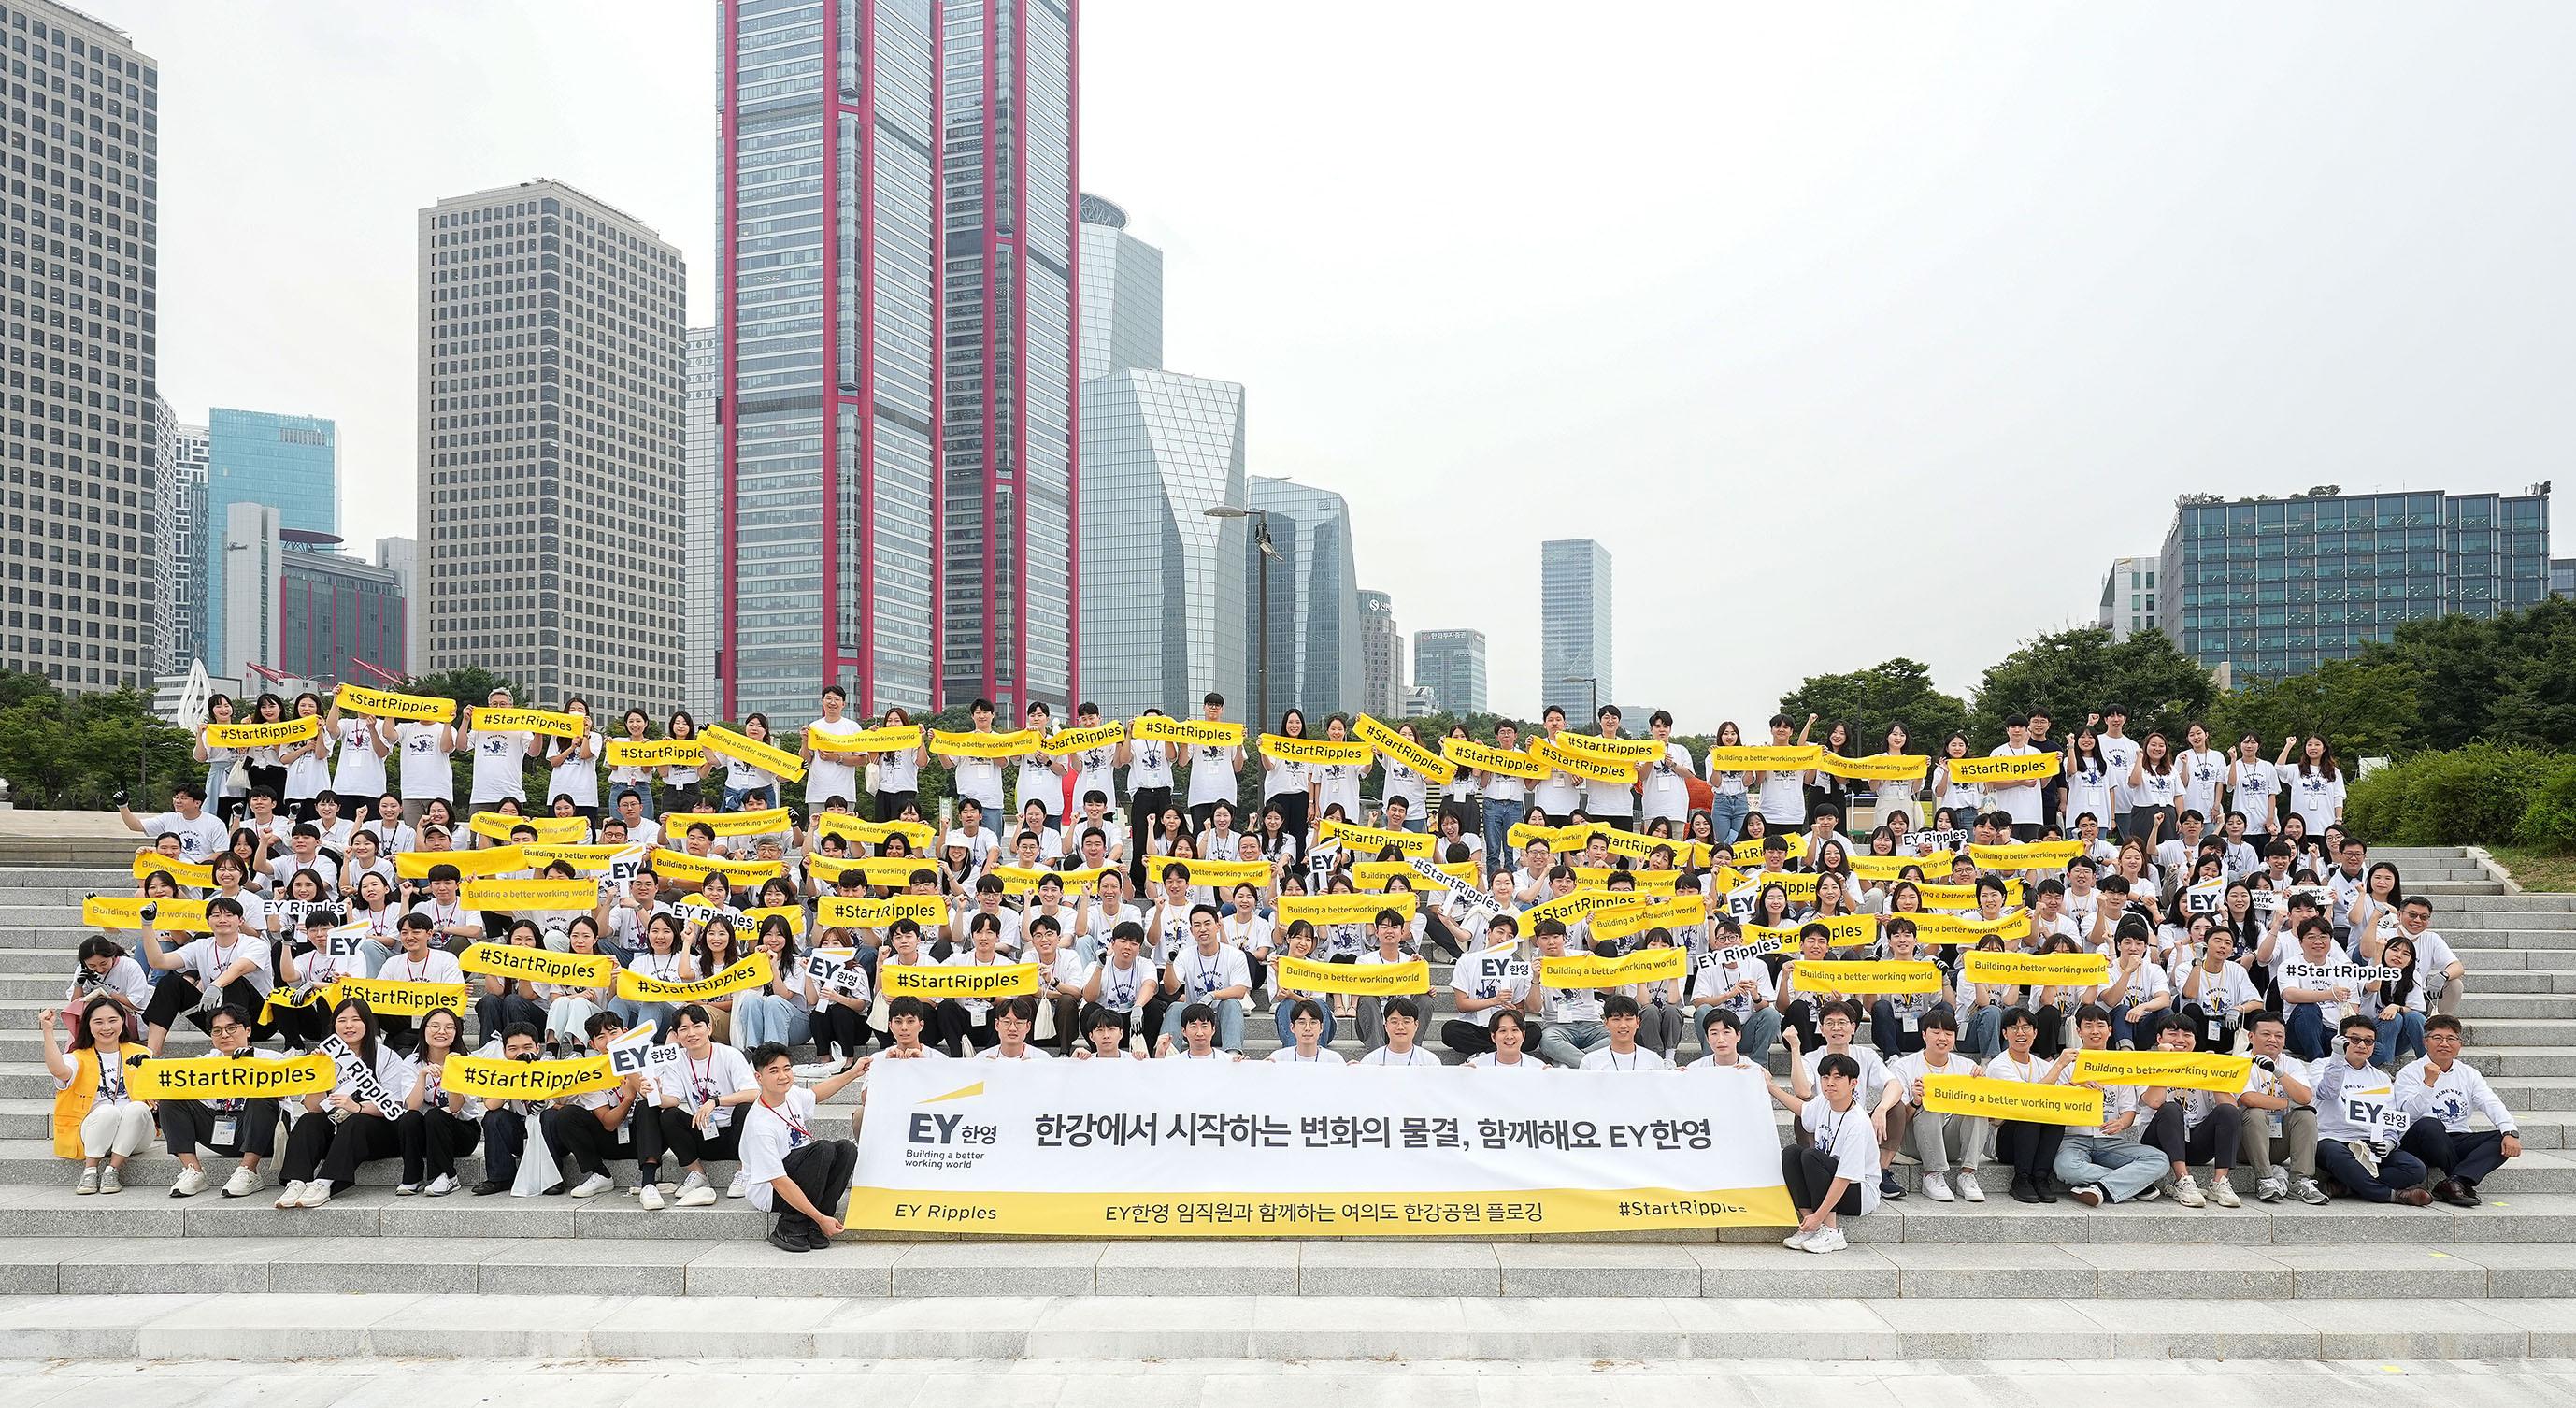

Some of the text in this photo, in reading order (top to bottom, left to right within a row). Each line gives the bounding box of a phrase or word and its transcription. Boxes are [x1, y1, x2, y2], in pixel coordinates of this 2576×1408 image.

[349, 693, 439, 713] #StartRipples
[484, 714, 572, 731] #StartRipples
[220, 723, 306, 740] #StartRipples
[1040, 726, 1121, 748] #StartRipples
[1146, 723, 1231, 740] #StartRipples
[621, 746, 704, 759] #StartRipple
[706, 729, 730, 747] Building
[737, 742, 758, 755] better
[757, 752, 782, 769] working
[782, 760, 801, 772] world
[1274, 741, 1362, 758] #StartRipples
[1366, 726, 1445, 775] #StartRipples
[1568, 737, 1652, 755] #StartRipples
[1455, 747, 1539, 772] #StartRipples
[1542, 748, 1624, 777] #StartRipples
[1961, 761, 2046, 775] #StartRipples
[1904, 830, 1968, 844] EY Ripples
[1311, 854, 1334, 870] EY
[1974, 853, 2002, 861] Building
[2058, 852, 2078, 860] world
[613, 862, 638, 879] EY
[657, 859, 687, 870] Building
[695, 864, 720, 874] better
[720, 868, 750, 877] working
[751, 869, 773, 877] world
[468, 890, 499, 898] Building
[1414, 859, 1501, 912] #StartRipples
[264, 901, 345, 914] EY Ripples
[1288, 906, 1319, 915] Building
[1354, 905, 1385, 914] working
[1731, 896, 1754, 914] EY
[2191, 894, 2217, 911] EY
[674, 906, 695, 918] EY
[835, 903, 935, 920] #StartRipples
[1596, 919, 1628, 927] Building
[330, 938, 362, 955] EY
[1698, 940, 1780, 969] EY Ripples
[480, 949, 594, 979] #StartRipples
[809, 957, 857, 986] EY 한영
[1482, 959, 1528, 976] EY 한영
[1547, 967, 1581, 976] Building
[1619, 962, 1652, 971] working
[1653, 958, 1677, 968] world
[1975, 961, 2011, 972] Building
[2048, 966, 2081, 975] working
[2083, 965, 2105, 973] world
[2286, 964, 2399, 979] #StartRipples
[637, 966, 756, 994] #StartRipples
[897, 973, 1018, 990] #StartRipples
[1287, 967, 1321, 981] Building
[1360, 976, 1394, 984] working
[1396, 973, 1419, 982] world
[1801, 970, 1835, 982] Building
[1872, 973, 1906, 982] working
[342, 984, 458, 1009] #StartRipples
[613, 1045, 677, 1072] EY 한영
[159, 1068, 316, 1088] #StartRipples
[329, 1036, 402, 1121] EY Ripples
[2084, 1062, 2124, 1075] Building
[2136, 1066, 2167, 1074] better
[2211, 1070, 2239, 1078] world
[464, 1068, 603, 1093] #StartRipples
[1935, 1088, 1976, 1103] Building
[1988, 1095, 2018, 1105] better
[2021, 1099, 2060, 1112] working
[2064, 1102, 2092, 1111] world
[2350, 1100, 2406, 1128] EY 한영
[909, 1113, 996, 1144] EY 한영
[1036, 1113, 1156, 1147] 한강에서
[1166, 1113, 1291, 1147] 시작하는
[1301, 1116, 1390, 1148] 변화의
[1478, 1118, 1601, 1151] 함께해요
[1610, 1119, 1711, 1150] EY한영
[907, 1149, 945, 1161] Building
[906, 1159, 942, 1170] working
[895, 1204, 996, 1221] EY Ripples
[1107, 1203, 1542, 1223] EY한영 임직원과 함께하는 여의도 한강공원 플로깅
